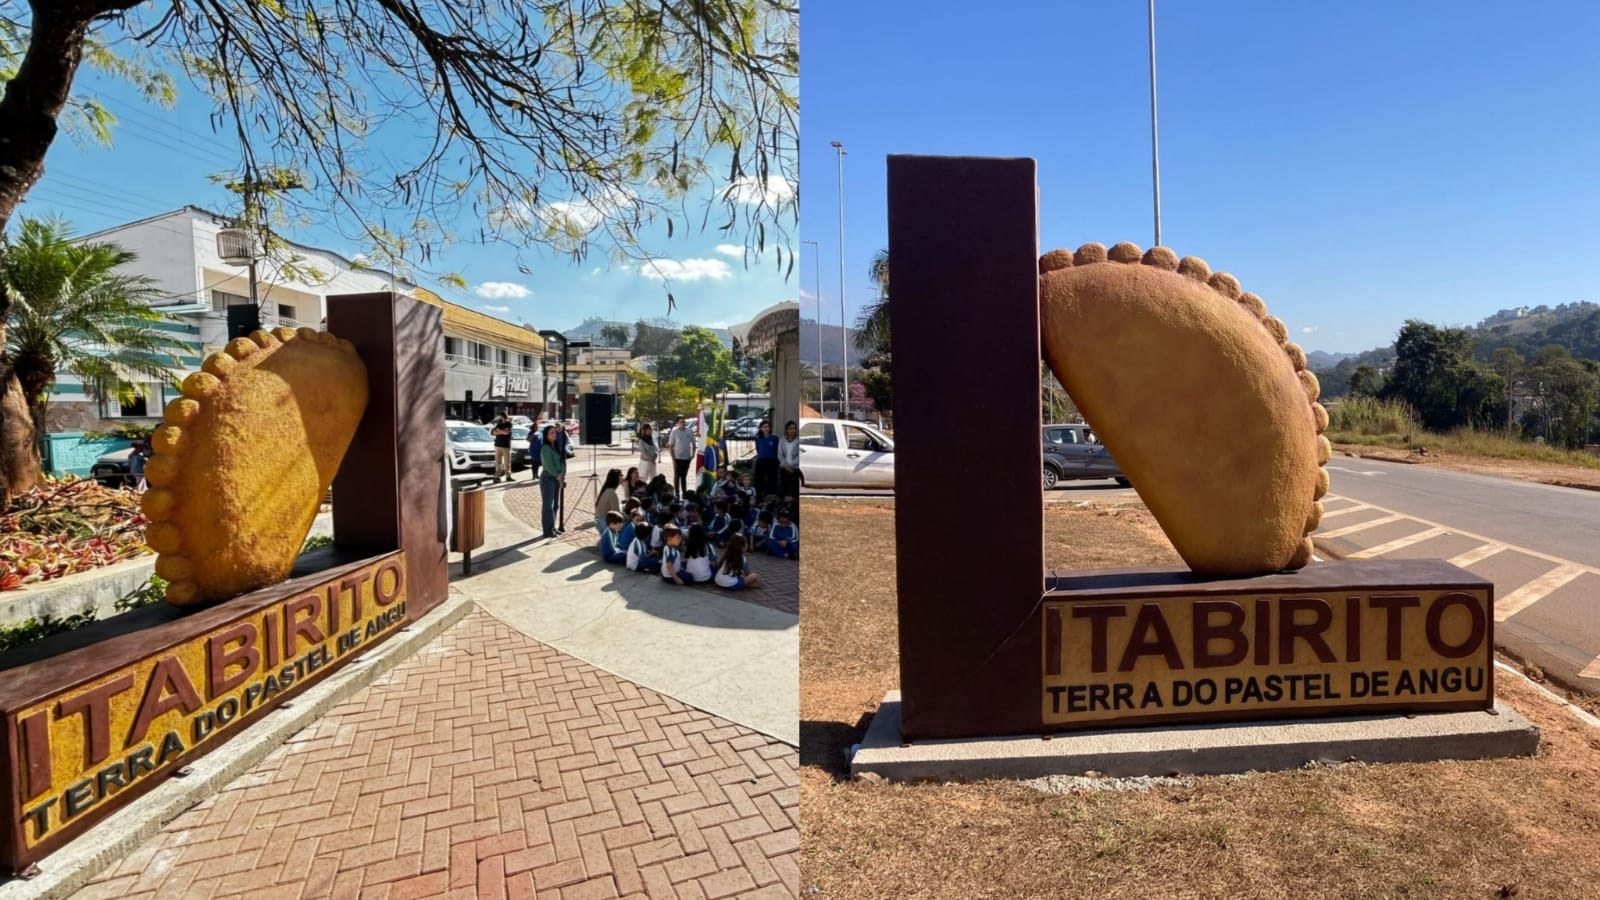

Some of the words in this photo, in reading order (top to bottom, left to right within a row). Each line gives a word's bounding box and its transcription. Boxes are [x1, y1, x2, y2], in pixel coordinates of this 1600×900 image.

[24, 560, 404, 799] ITABIRITO
[1045, 592, 1486, 676] ITABIRITO
[1046, 680, 1164, 714] TERRA
[1172, 678, 1218, 707] DO
[1225, 674, 1341, 704] PASTEL
[1350, 670, 1389, 698] DE
[1394, 666, 1484, 696] ANGU
[22, 731, 186, 840] TERRA
[192, 697, 239, 743] DO
[244, 645, 334, 711] PASTEL
[337, 627, 362, 653] DE
[364, 601, 406, 640] ANGU
